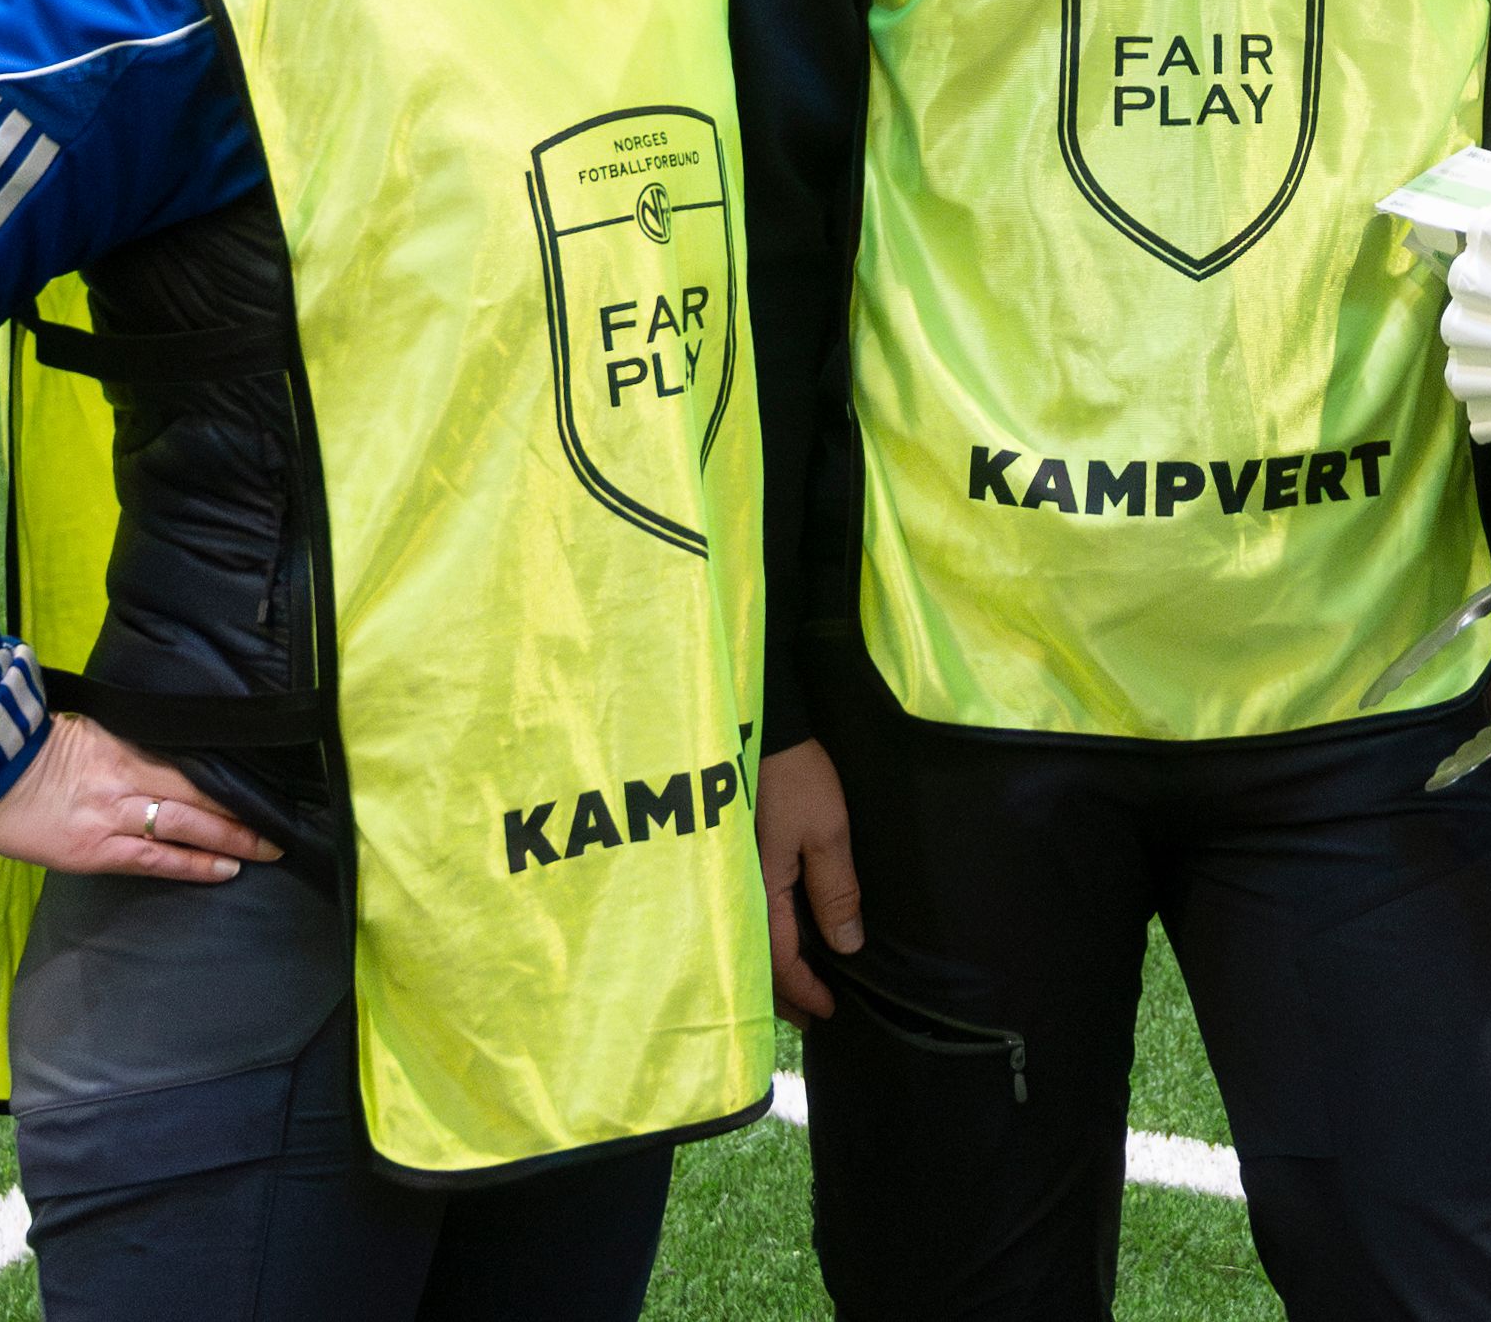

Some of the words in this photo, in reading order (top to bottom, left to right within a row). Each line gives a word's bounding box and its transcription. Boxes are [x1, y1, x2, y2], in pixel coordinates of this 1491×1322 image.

[1114, 34, 1273, 76] FAIR
[1114, 83, 1273, 126] PLAY
[578, 150, 700, 184] FOTBALLFORBUND
[614, 130, 668, 153] NORGES
[600, 285, 709, 352] FAR
[606, 338, 703, 407] PLY
[968, 440, 1391, 517] KAMPVERT
[504, 753, 751, 874] KAMP
